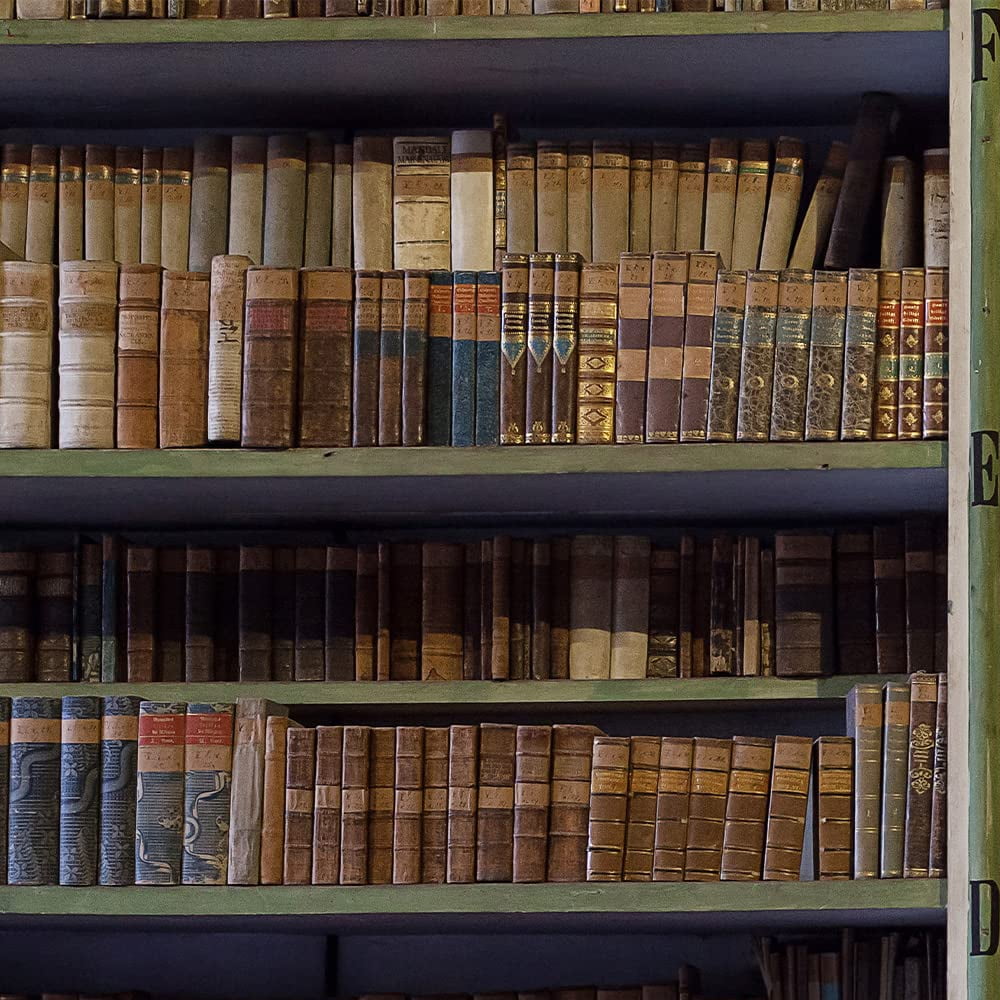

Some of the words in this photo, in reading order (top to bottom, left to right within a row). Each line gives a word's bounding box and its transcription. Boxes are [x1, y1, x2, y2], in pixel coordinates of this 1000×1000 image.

[972, 8, 1000, 83] F
[971, 430, 999, 507] E
[969, 879, 1000, 956] D
